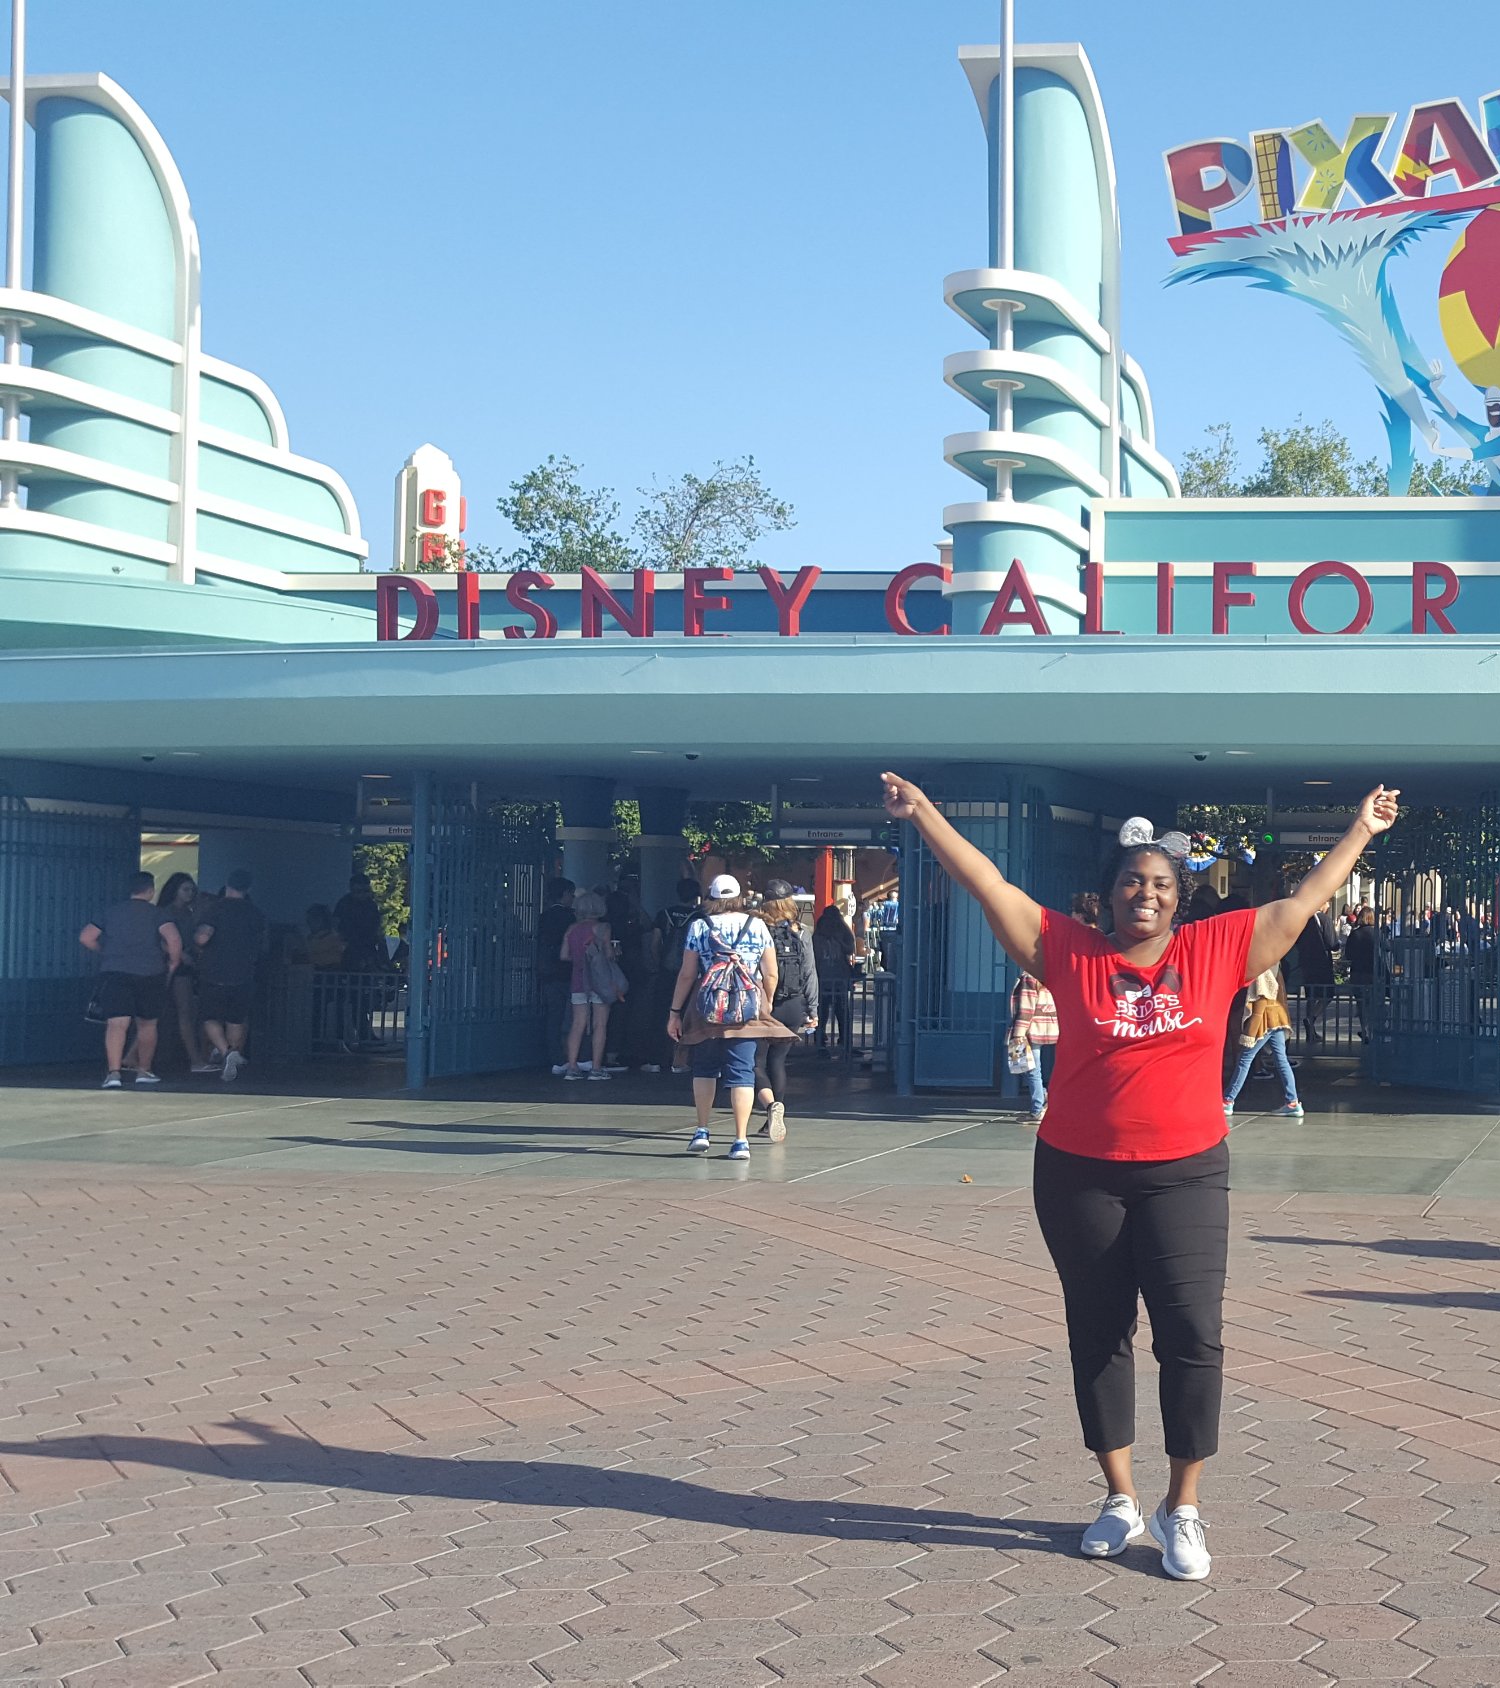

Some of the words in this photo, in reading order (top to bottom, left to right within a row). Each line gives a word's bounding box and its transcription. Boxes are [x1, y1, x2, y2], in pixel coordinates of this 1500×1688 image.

[376, 565, 821, 641] DISNEY
[807, 830, 844, 838] Entrance
[1308, 834, 1341, 842] Entranc
[1115, 994, 1180, 1018] BRIDE'S
[1094, 1010, 1203, 1038] mouse
